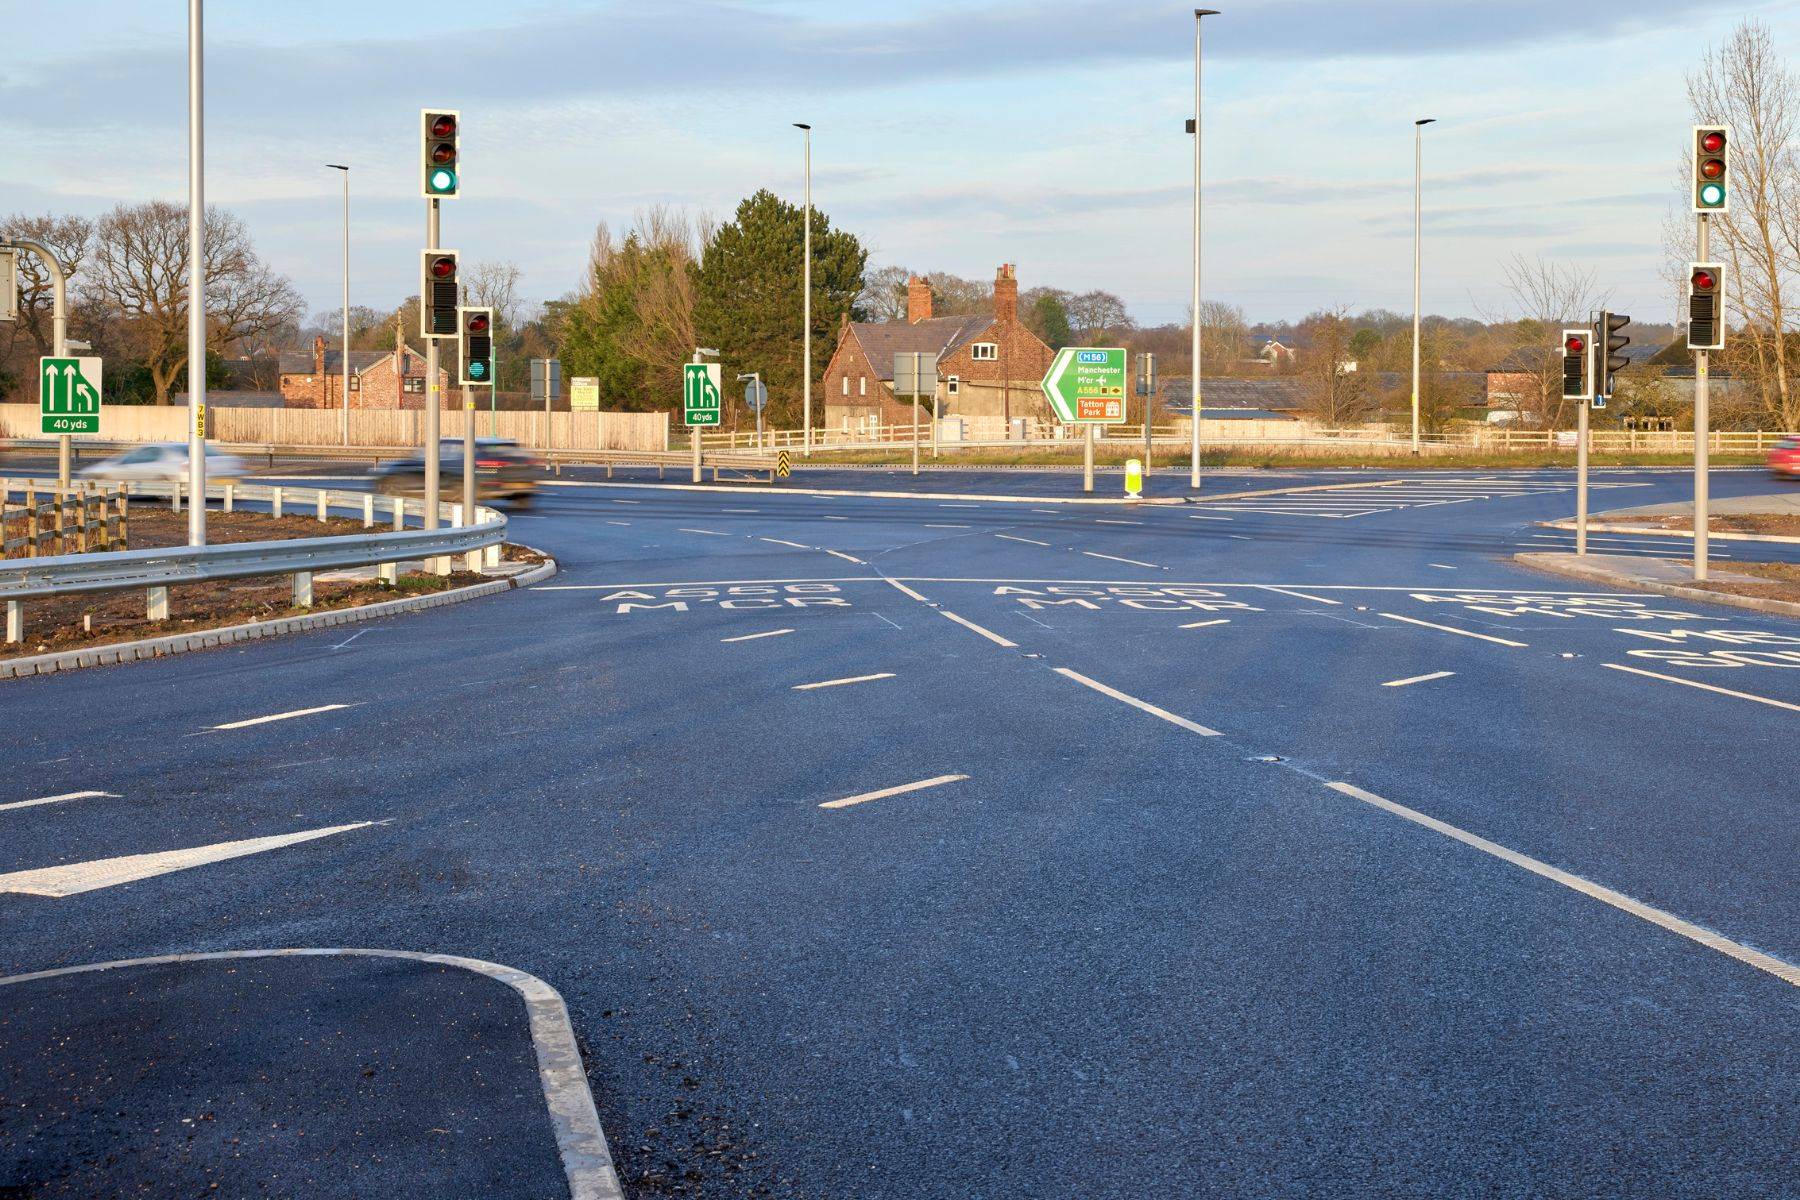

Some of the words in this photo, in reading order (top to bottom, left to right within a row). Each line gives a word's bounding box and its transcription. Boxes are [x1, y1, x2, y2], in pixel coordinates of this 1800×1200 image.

[1078, 366, 1120, 374] Manchester
[1080, 400, 1104, 408] Tatton
[1084, 408, 1101, 416] Park
[692, 414, 702, 422] 40
[702, 413, 713, 423] yds
[53, 419, 69, 429] 40
[70, 419, 88, 431] yds
[1626, 649, 1800, 668] SO
